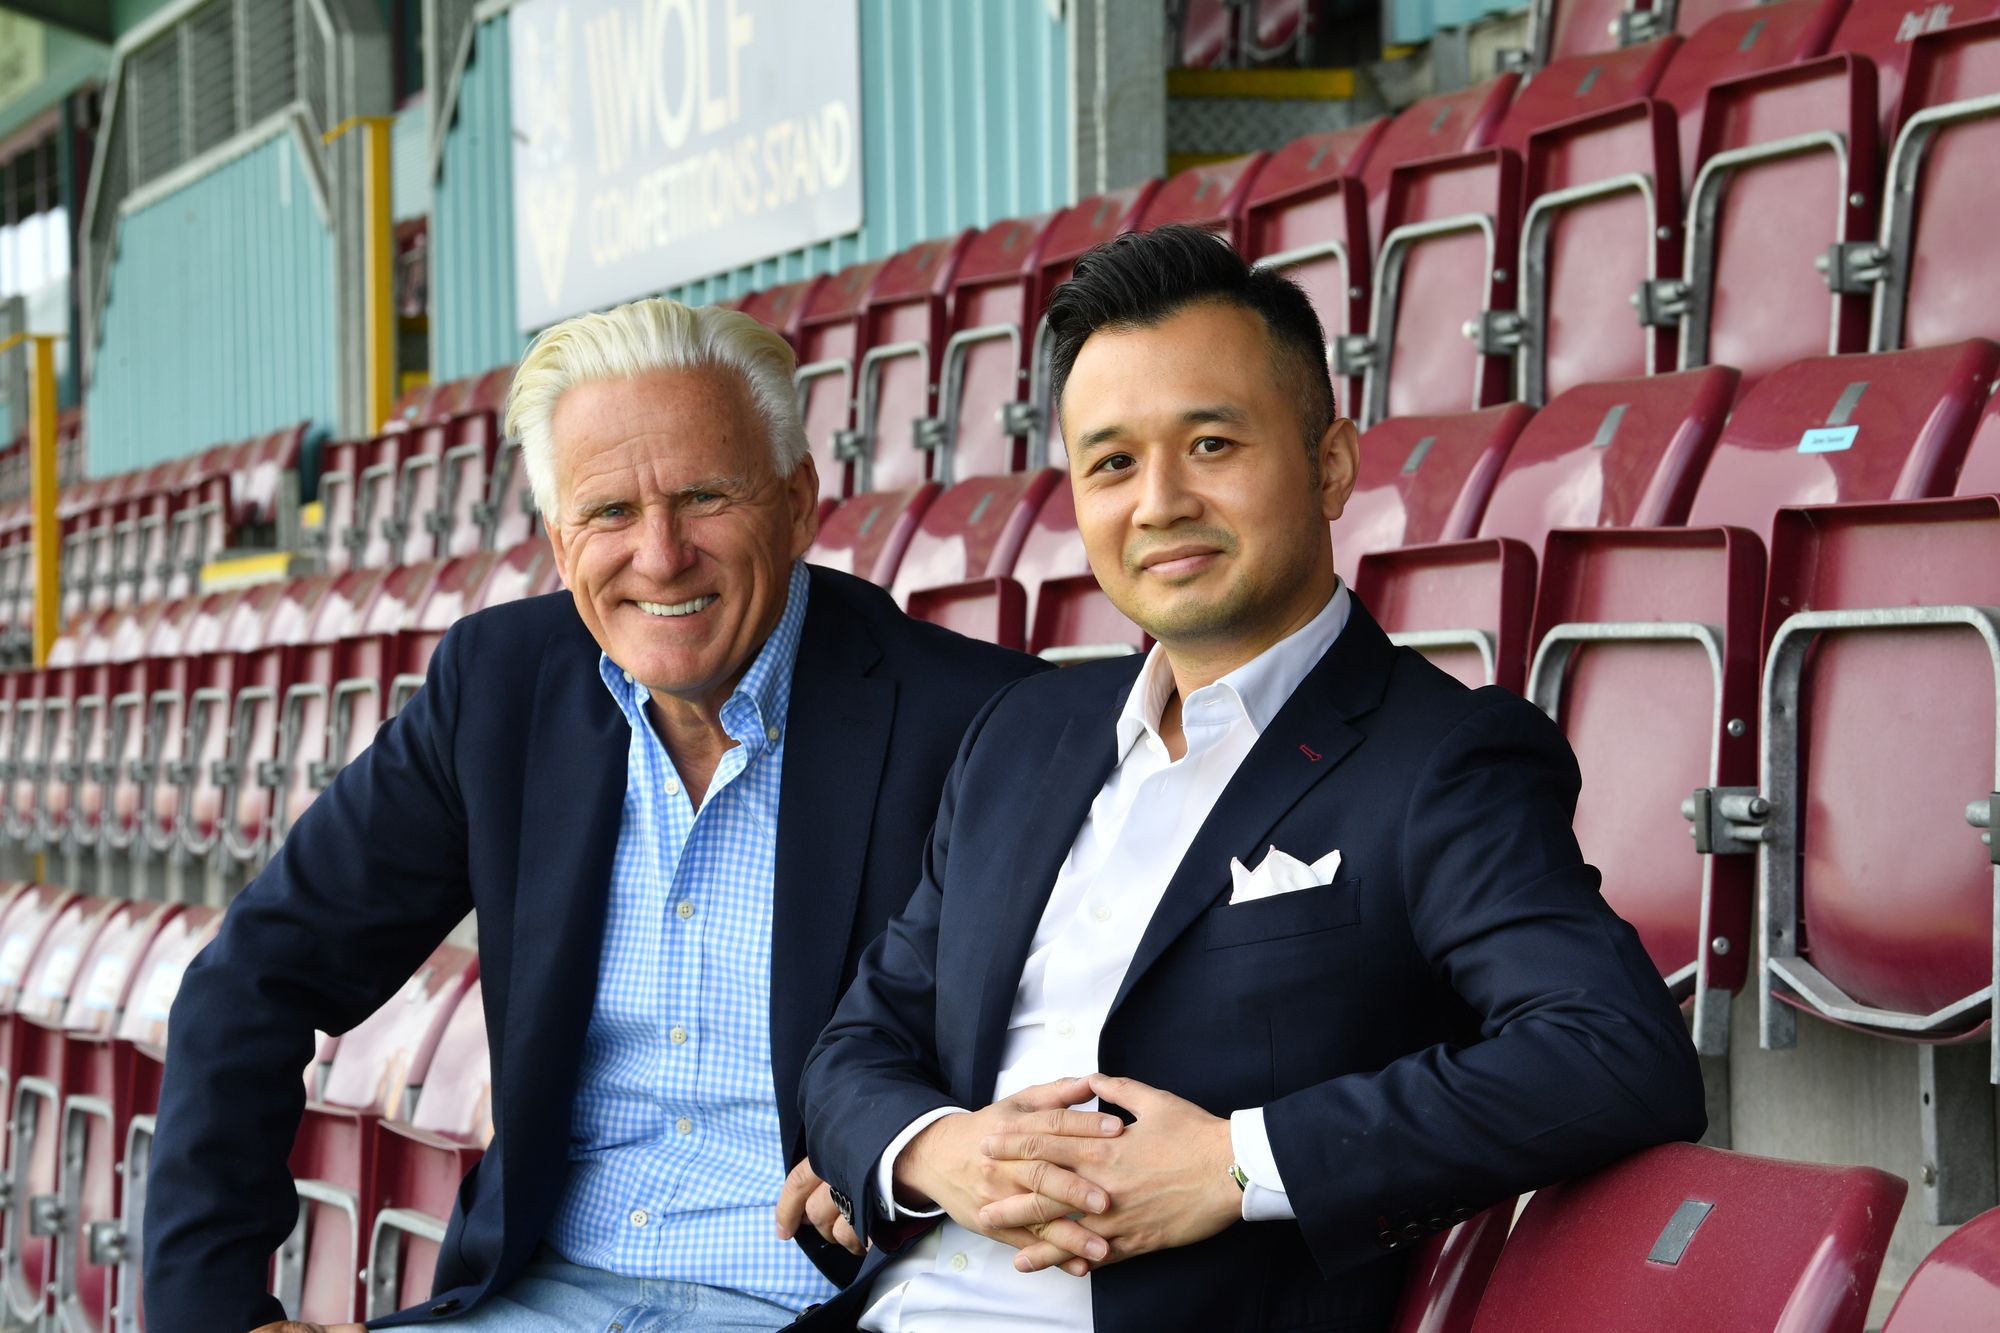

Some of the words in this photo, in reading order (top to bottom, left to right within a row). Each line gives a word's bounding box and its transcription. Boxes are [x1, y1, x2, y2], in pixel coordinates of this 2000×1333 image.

[597, 0, 753, 160] WOLF
[589, 133, 760, 266] COMPETITIONS
[763, 100, 851, 210] STAND
